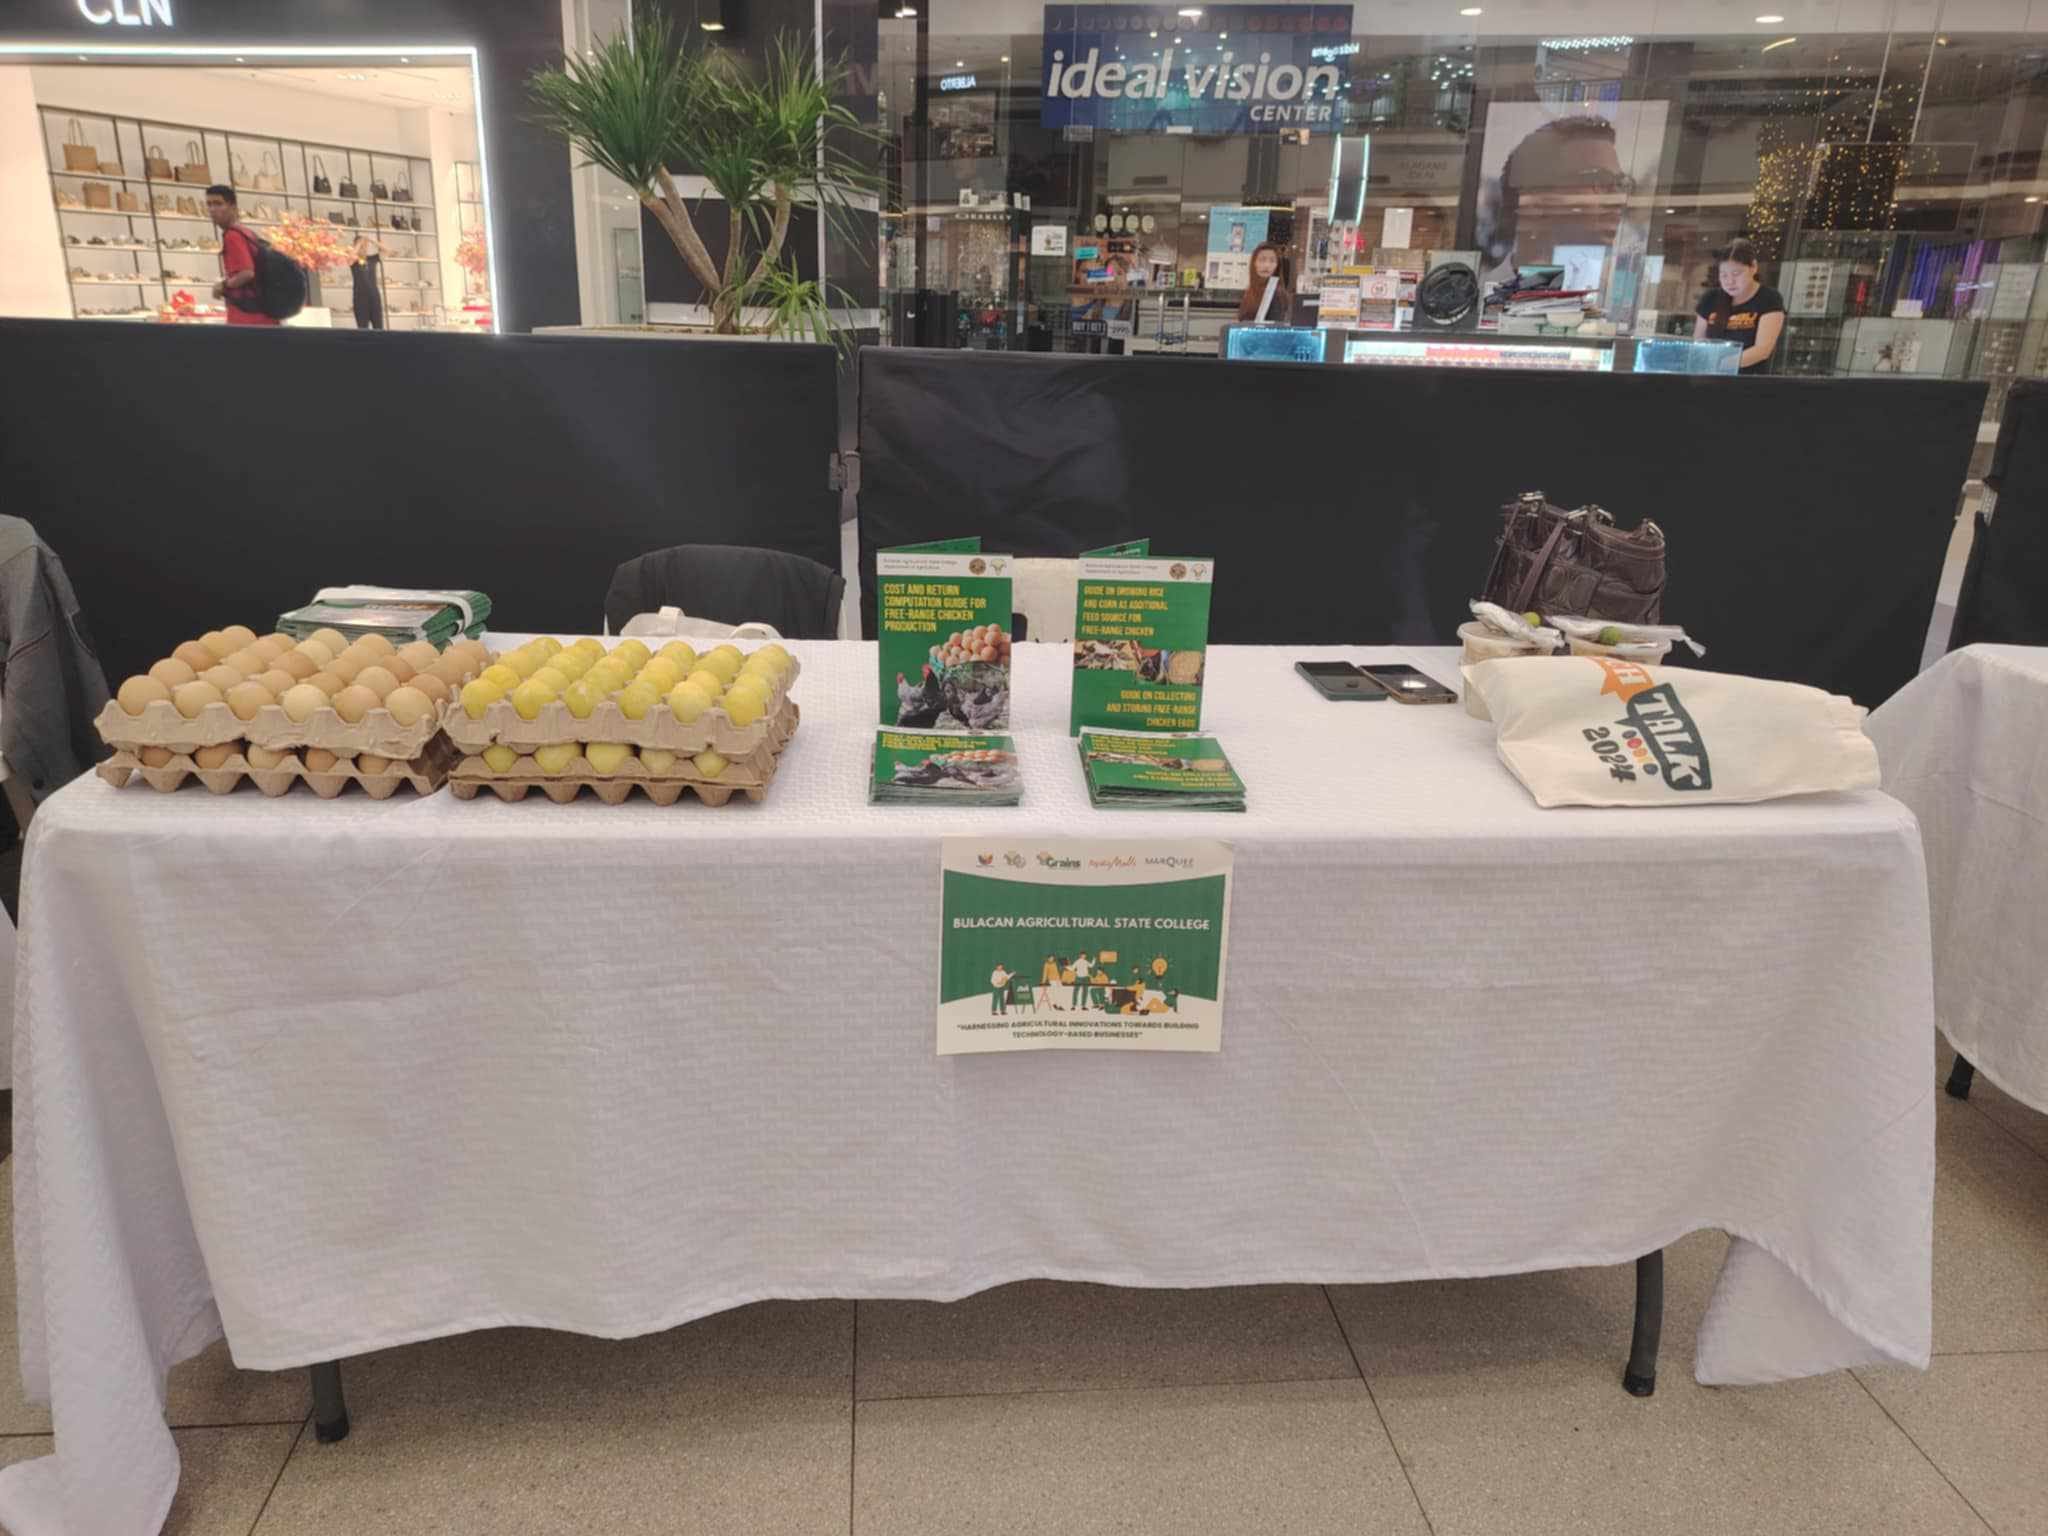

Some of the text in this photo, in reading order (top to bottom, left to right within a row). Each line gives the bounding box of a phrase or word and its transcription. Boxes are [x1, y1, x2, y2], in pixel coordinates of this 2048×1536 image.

[78, 0, 174, 26] CLN
[1047, 49, 1340, 101] ideal vision
[1250, 104, 1332, 122] CENTER
[884, 584, 960, 595] COST AND RETURN
[884, 596, 986, 608] COMPUTATION GUIDE FOR
[884, 608, 974, 621] FREE-RANGE CHICKEN
[884, 621, 937, 632] PRODUCTION
[1633, 692, 1703, 787] TALK
[1582, 726, 1637, 783] 2024
[1046, 857, 1081, 868] Grains
[953, 917, 1210, 930] BULACAN AGRICULTURAL STATE COLLEGE
